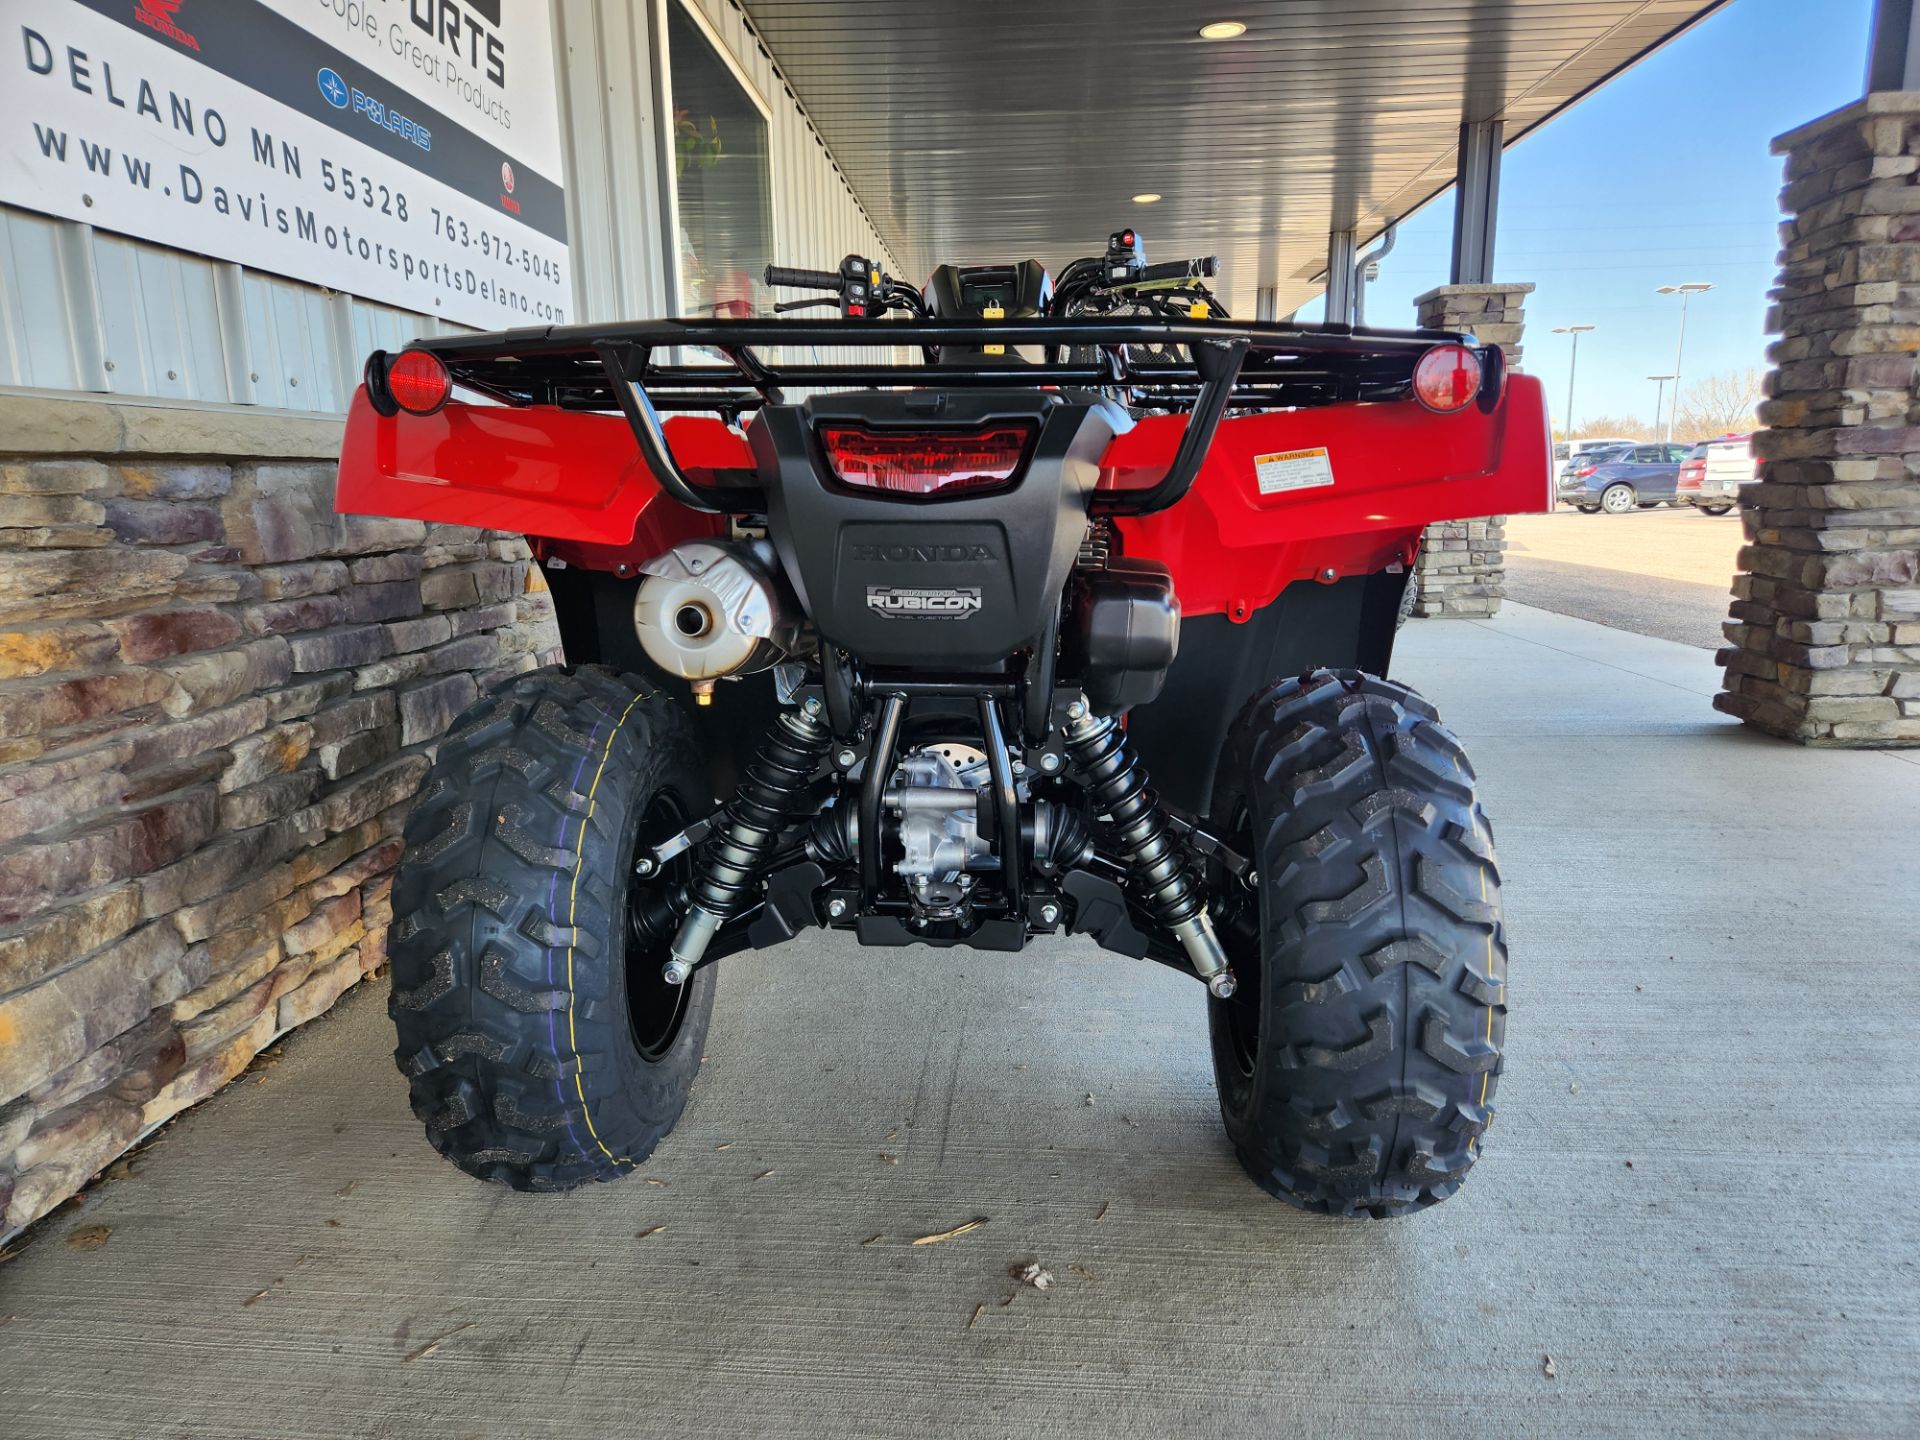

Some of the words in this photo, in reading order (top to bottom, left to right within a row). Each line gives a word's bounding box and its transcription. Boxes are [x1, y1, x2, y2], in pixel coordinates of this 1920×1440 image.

[134, 6, 200, 51] HONDA
[382, 0, 504, 89] ORTS
[389, 23, 441, 83] Great
[447, 61, 511, 130] Products
[21, 24, 227, 147] DELANO
[251, 127, 301, 179] MN
[321, 158, 408, 222] 55328
[431, 207, 560, 285] 763-972-5045
[351, 88, 430, 150] POLARIS
[33, 121, 565, 325] www.DavisMotorsportsDelano.com
[853, 544, 999, 561] HONDA
[867, 595, 981, 609] RUBICON
